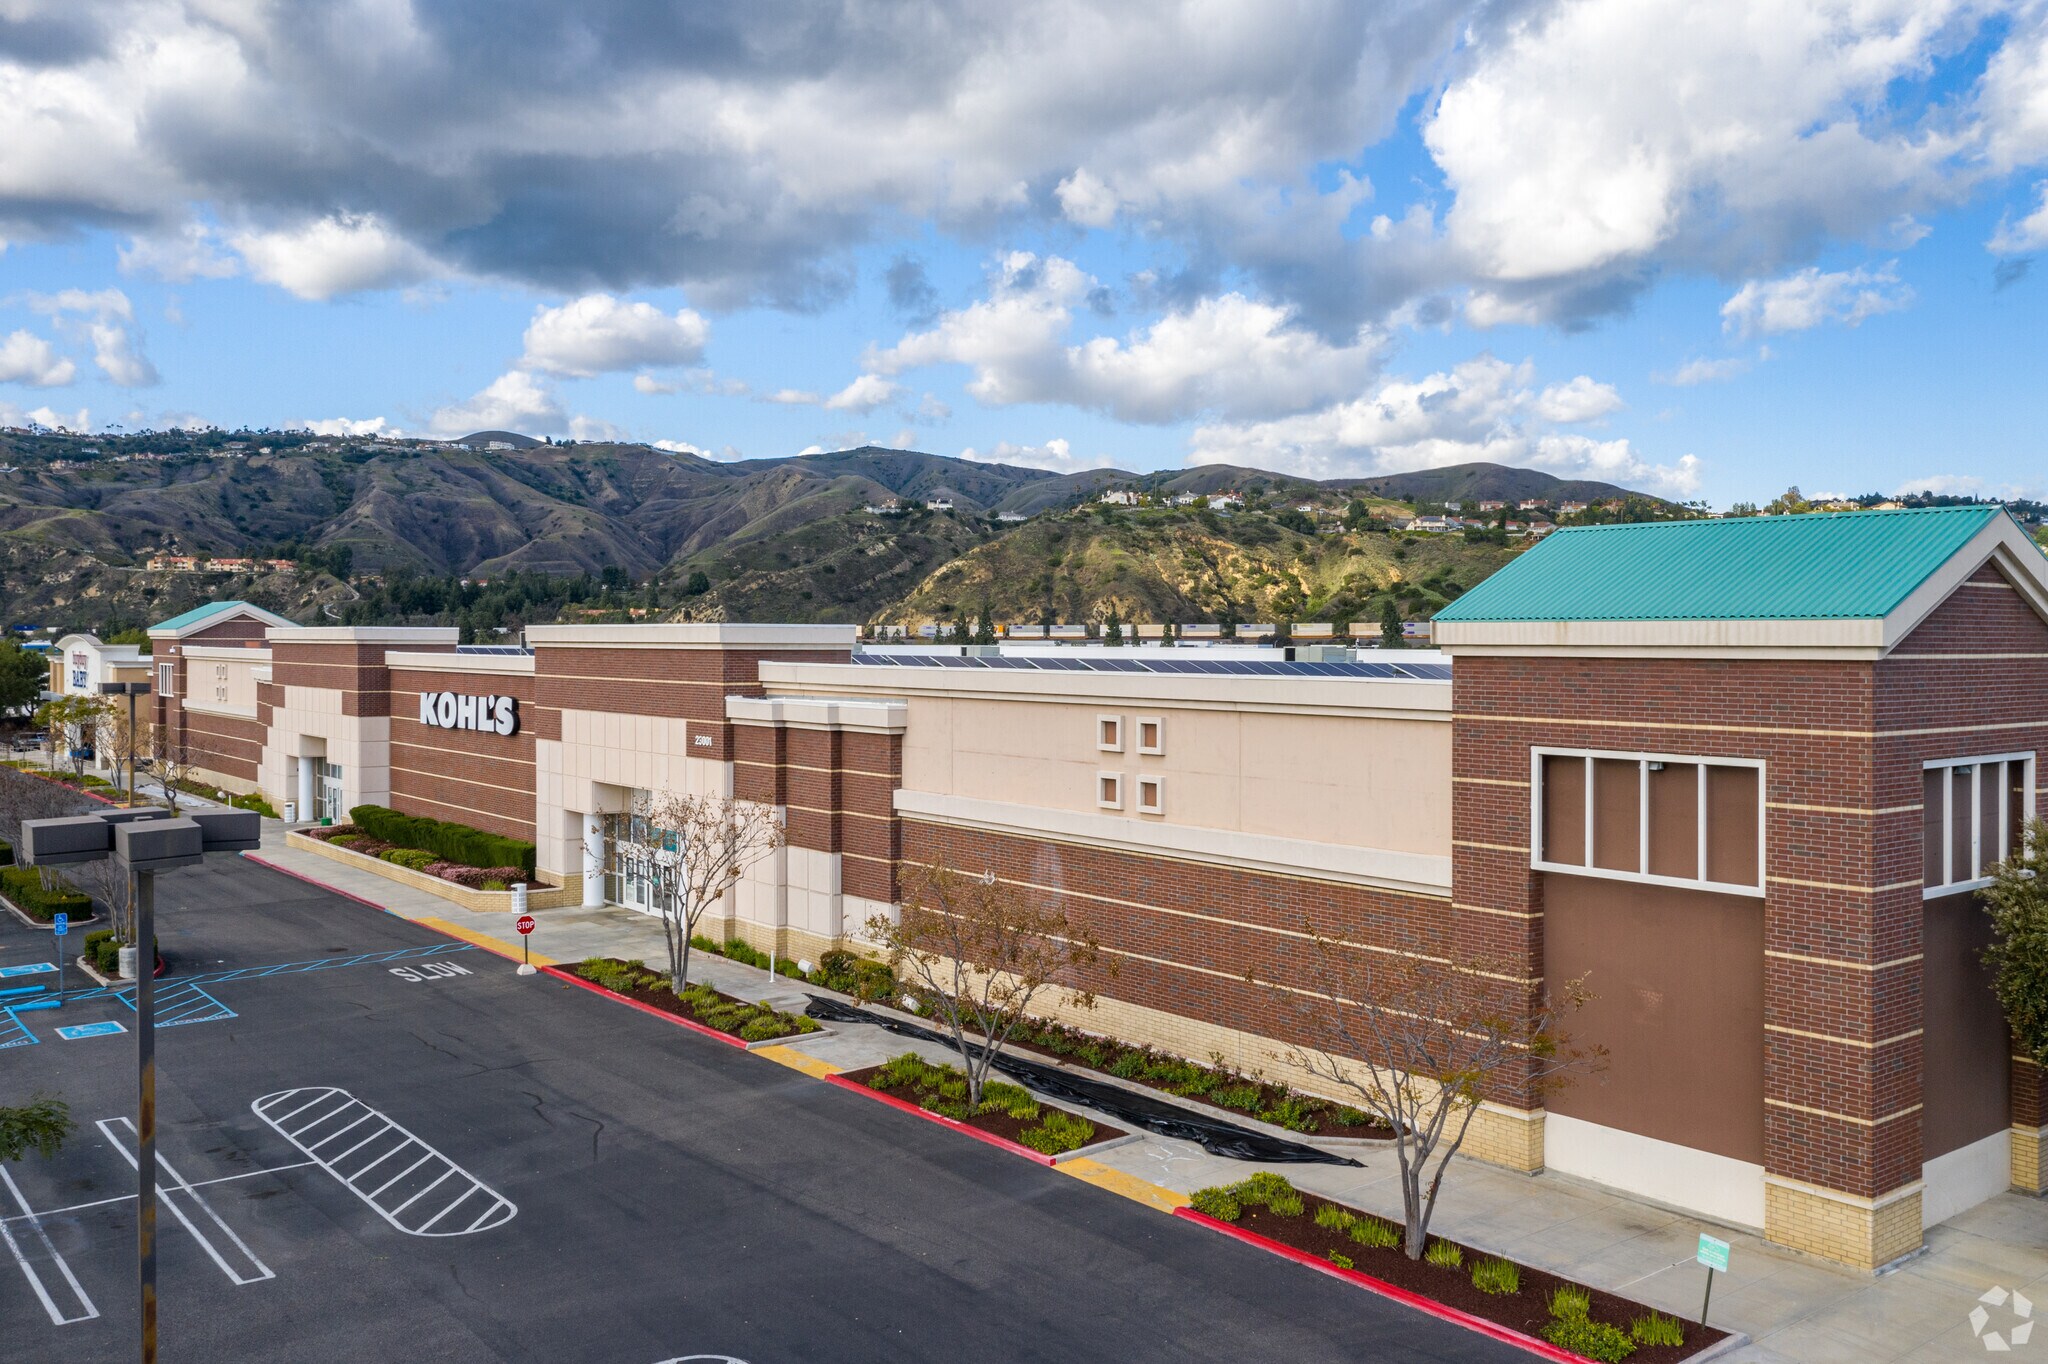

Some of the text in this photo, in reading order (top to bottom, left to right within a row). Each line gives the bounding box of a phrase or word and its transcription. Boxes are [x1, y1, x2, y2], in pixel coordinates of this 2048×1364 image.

[420, 691, 516, 736] KOHL'S
[517, 920, 534, 929] STOP
[388, 961, 474, 982] SLOW
